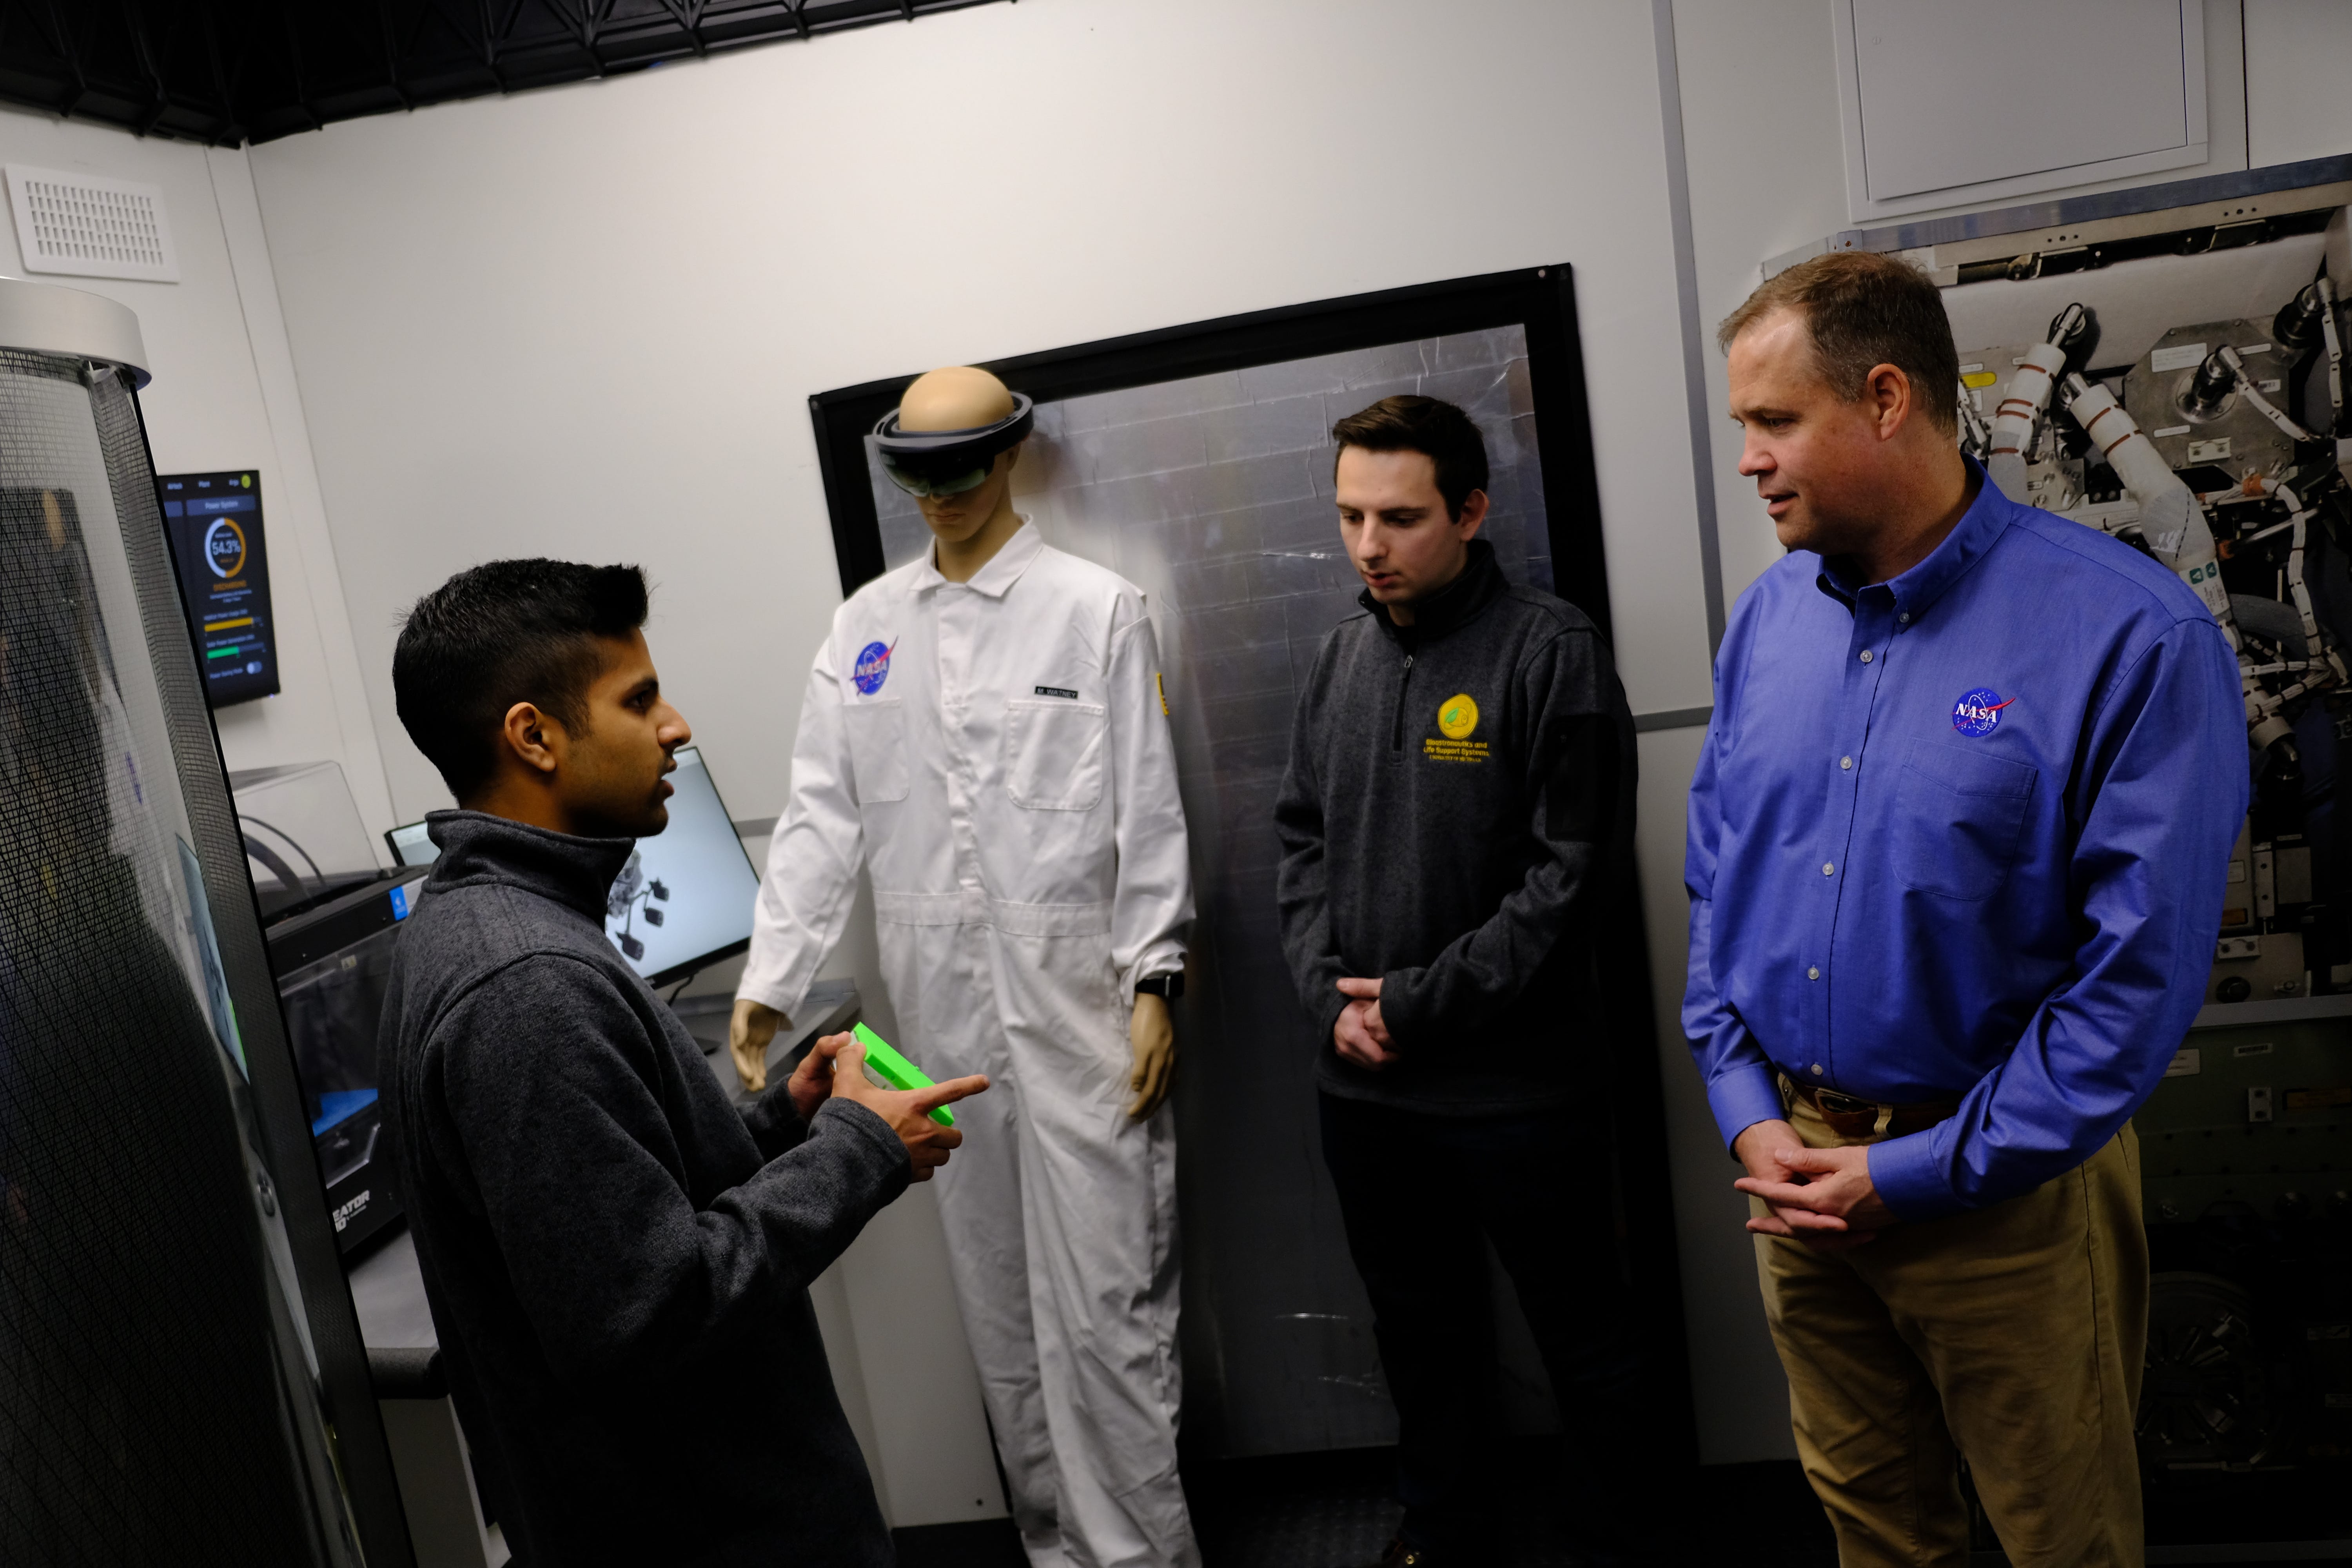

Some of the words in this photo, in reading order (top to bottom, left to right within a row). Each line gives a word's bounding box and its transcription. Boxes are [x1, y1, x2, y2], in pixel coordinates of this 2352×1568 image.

[857, 660, 887, 677] NASA
[1047, 689, 1076, 698] WATNEY
[1955, 703, 1997, 723] NASA
